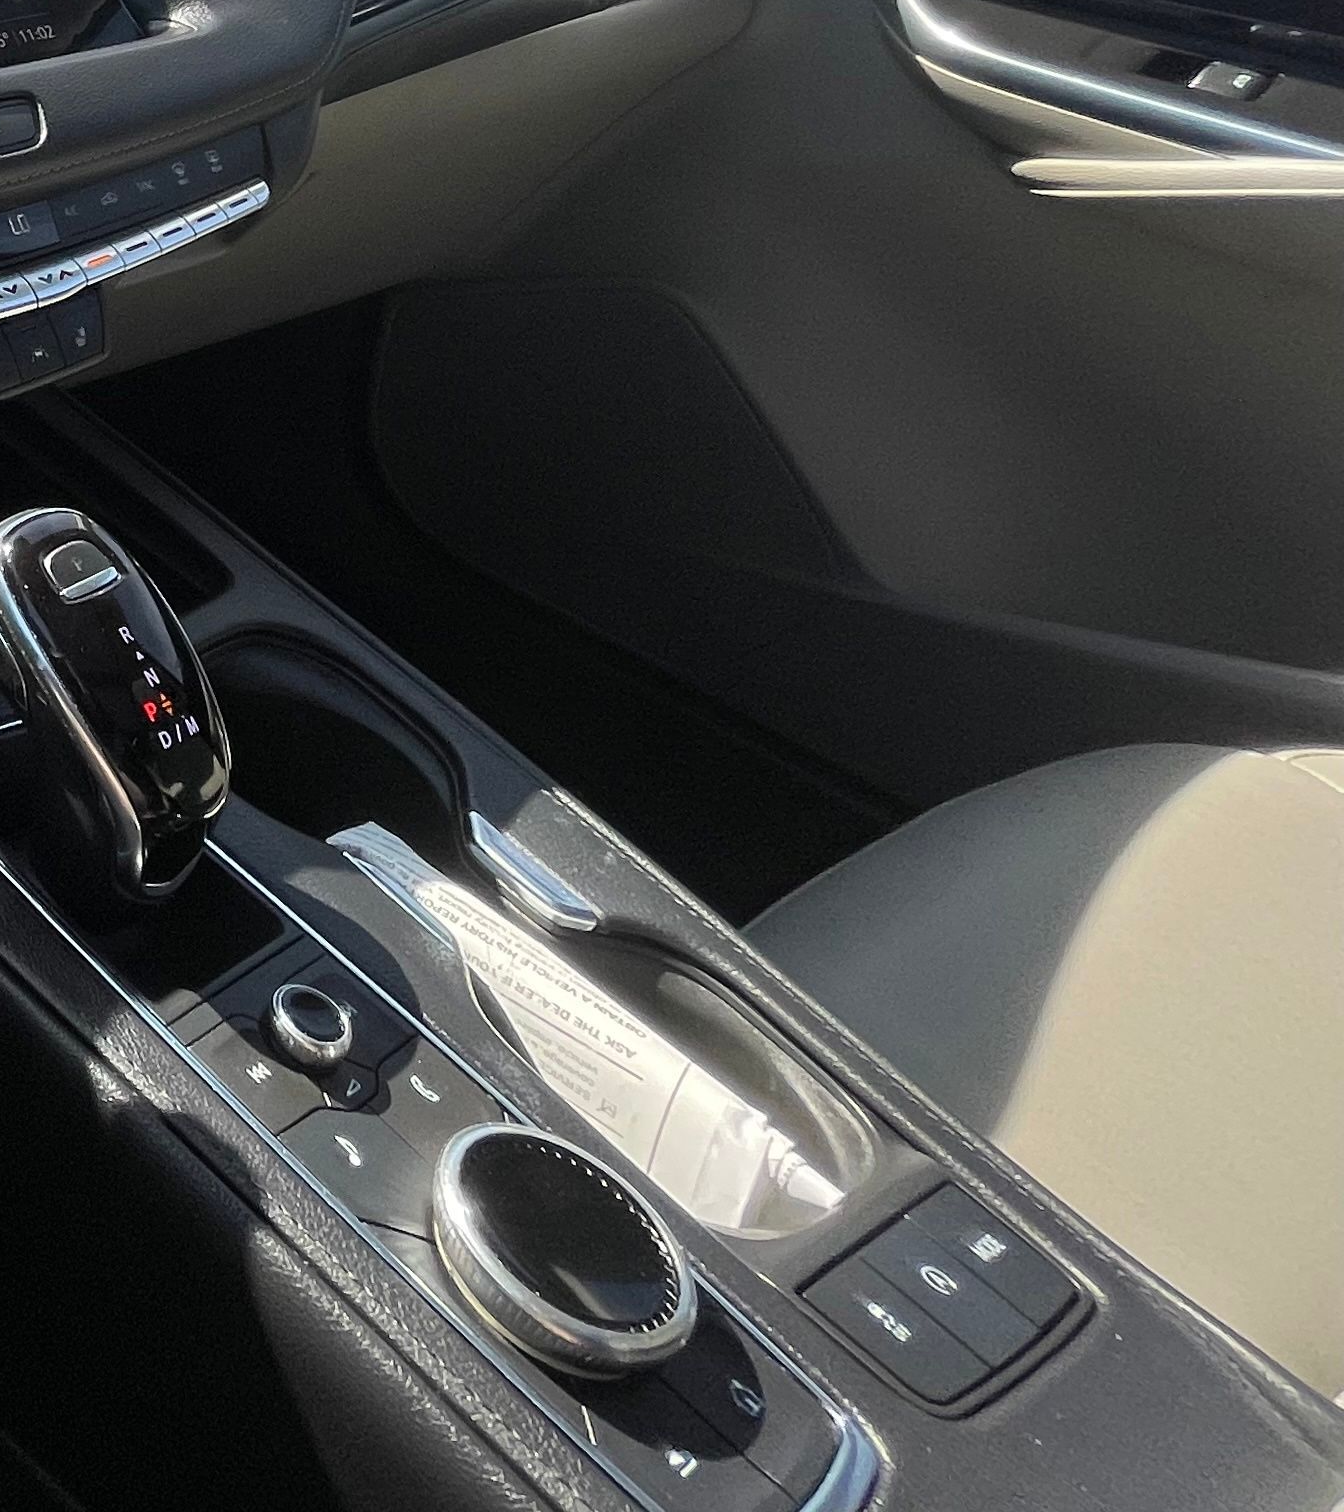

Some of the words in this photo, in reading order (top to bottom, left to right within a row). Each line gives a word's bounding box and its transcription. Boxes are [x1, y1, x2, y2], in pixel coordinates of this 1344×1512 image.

[19, 25, 56, 43] 11:02
[118, 626, 134, 642] R
[143, 668, 160, 687] N
[142, 702, 157, 722] P
[459, 919, 518, 960] HISTORY
[513, 980, 572, 1022] DEALER
[570, 1014, 604, 1041] THE
[591, 1001, 648, 1040] OBTAIN
[602, 1034, 637, 1061] ASK
